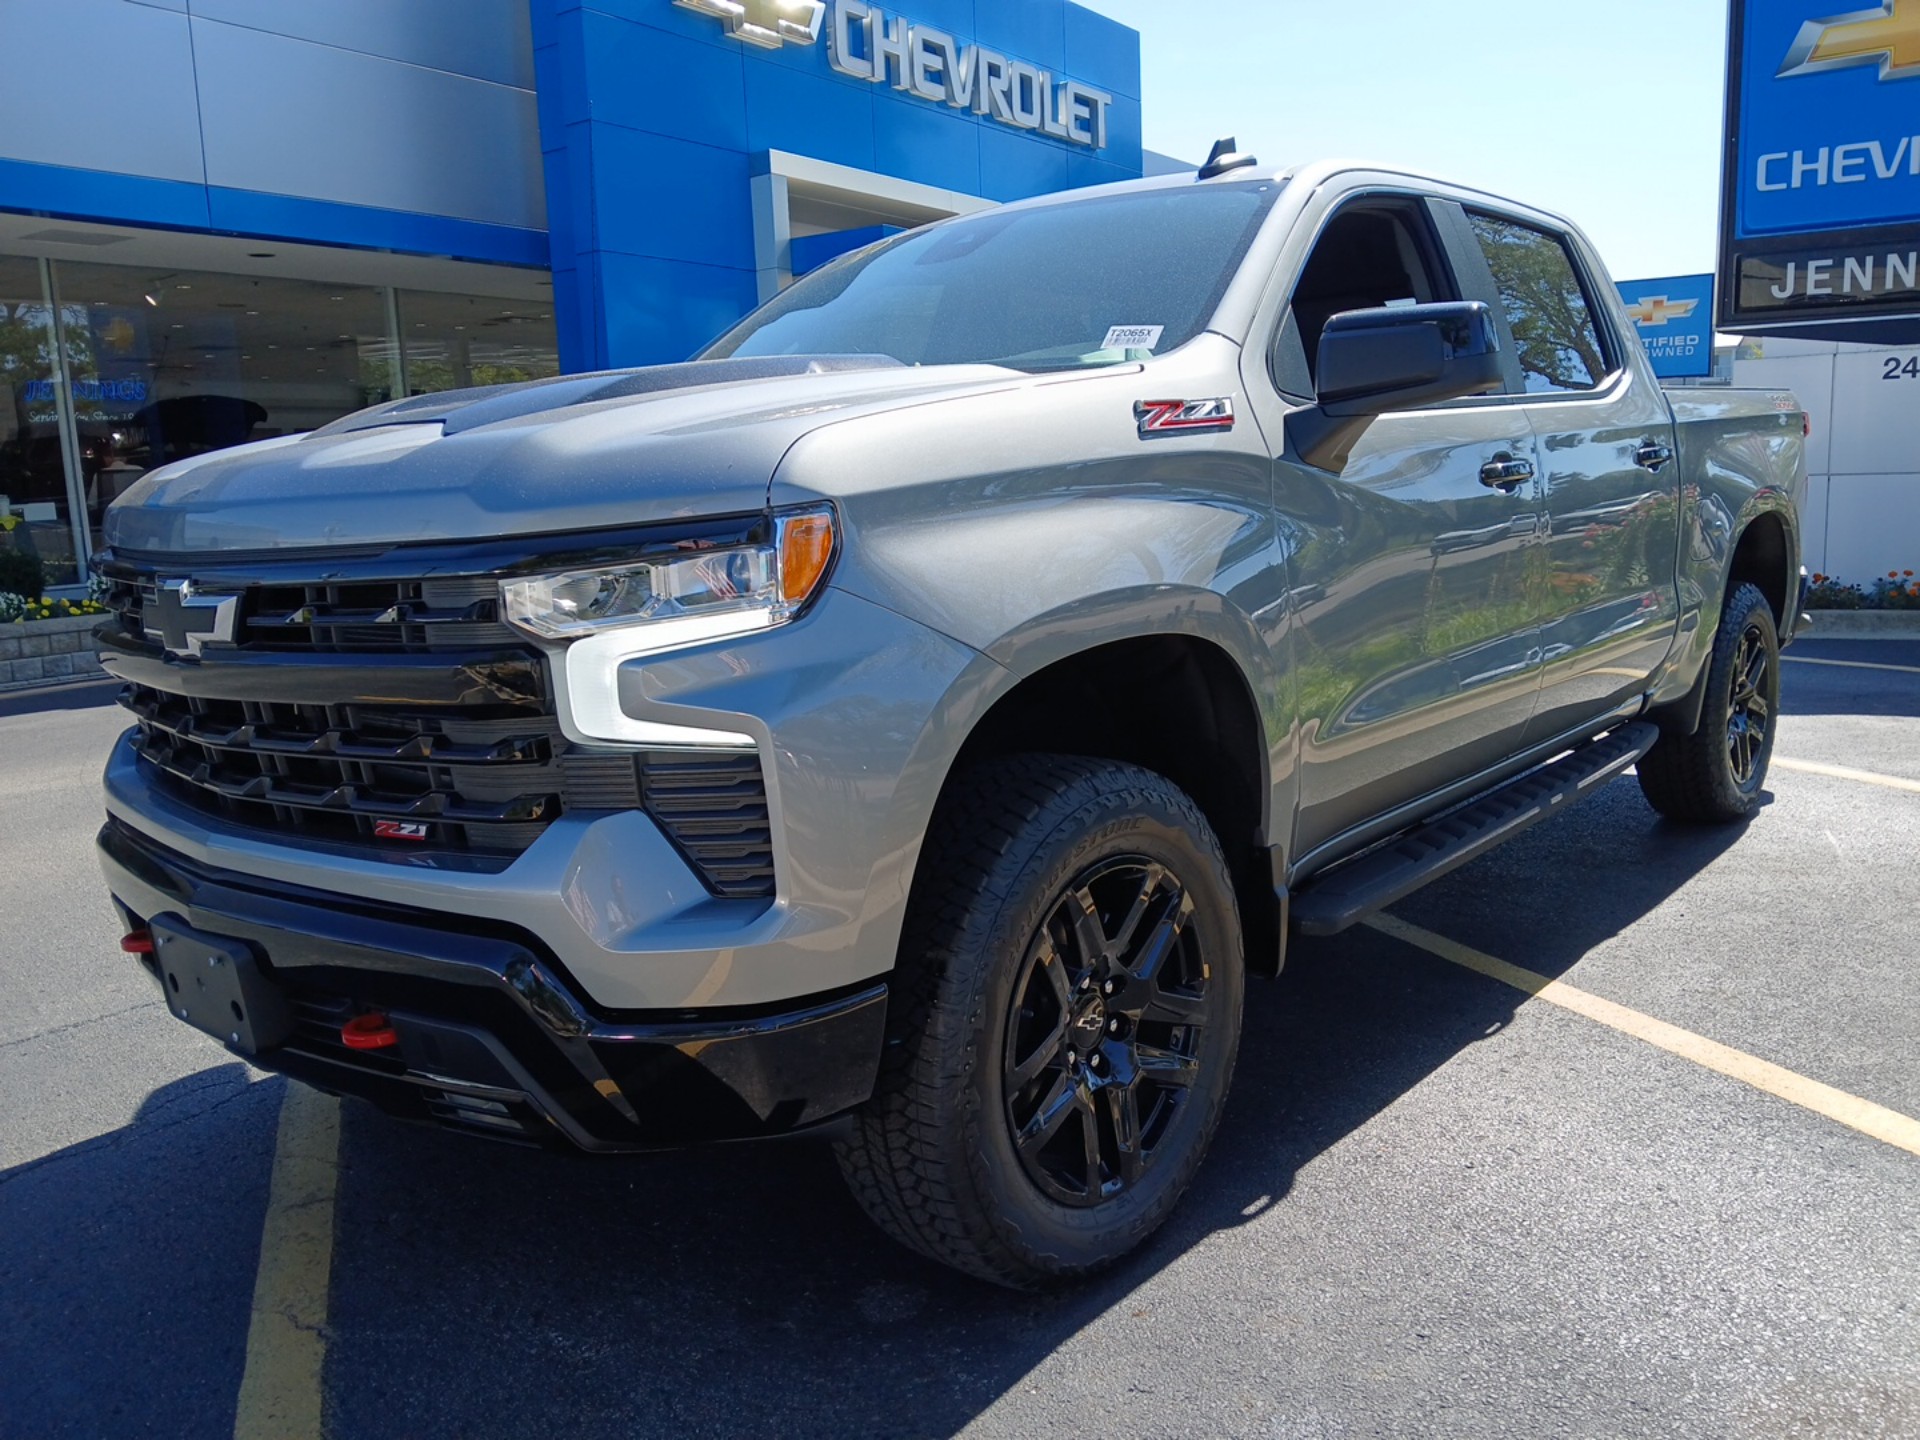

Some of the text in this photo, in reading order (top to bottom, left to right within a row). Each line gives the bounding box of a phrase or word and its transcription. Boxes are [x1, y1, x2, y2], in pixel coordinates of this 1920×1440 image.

[827, 0, 1112, 150] CHEVROLET
[1882, 356, 1920, 380] 24
[25, 379, 146, 401] JENINGS
[1133, 397, 1236, 434] Z71
[375, 820, 429, 841] Z71
